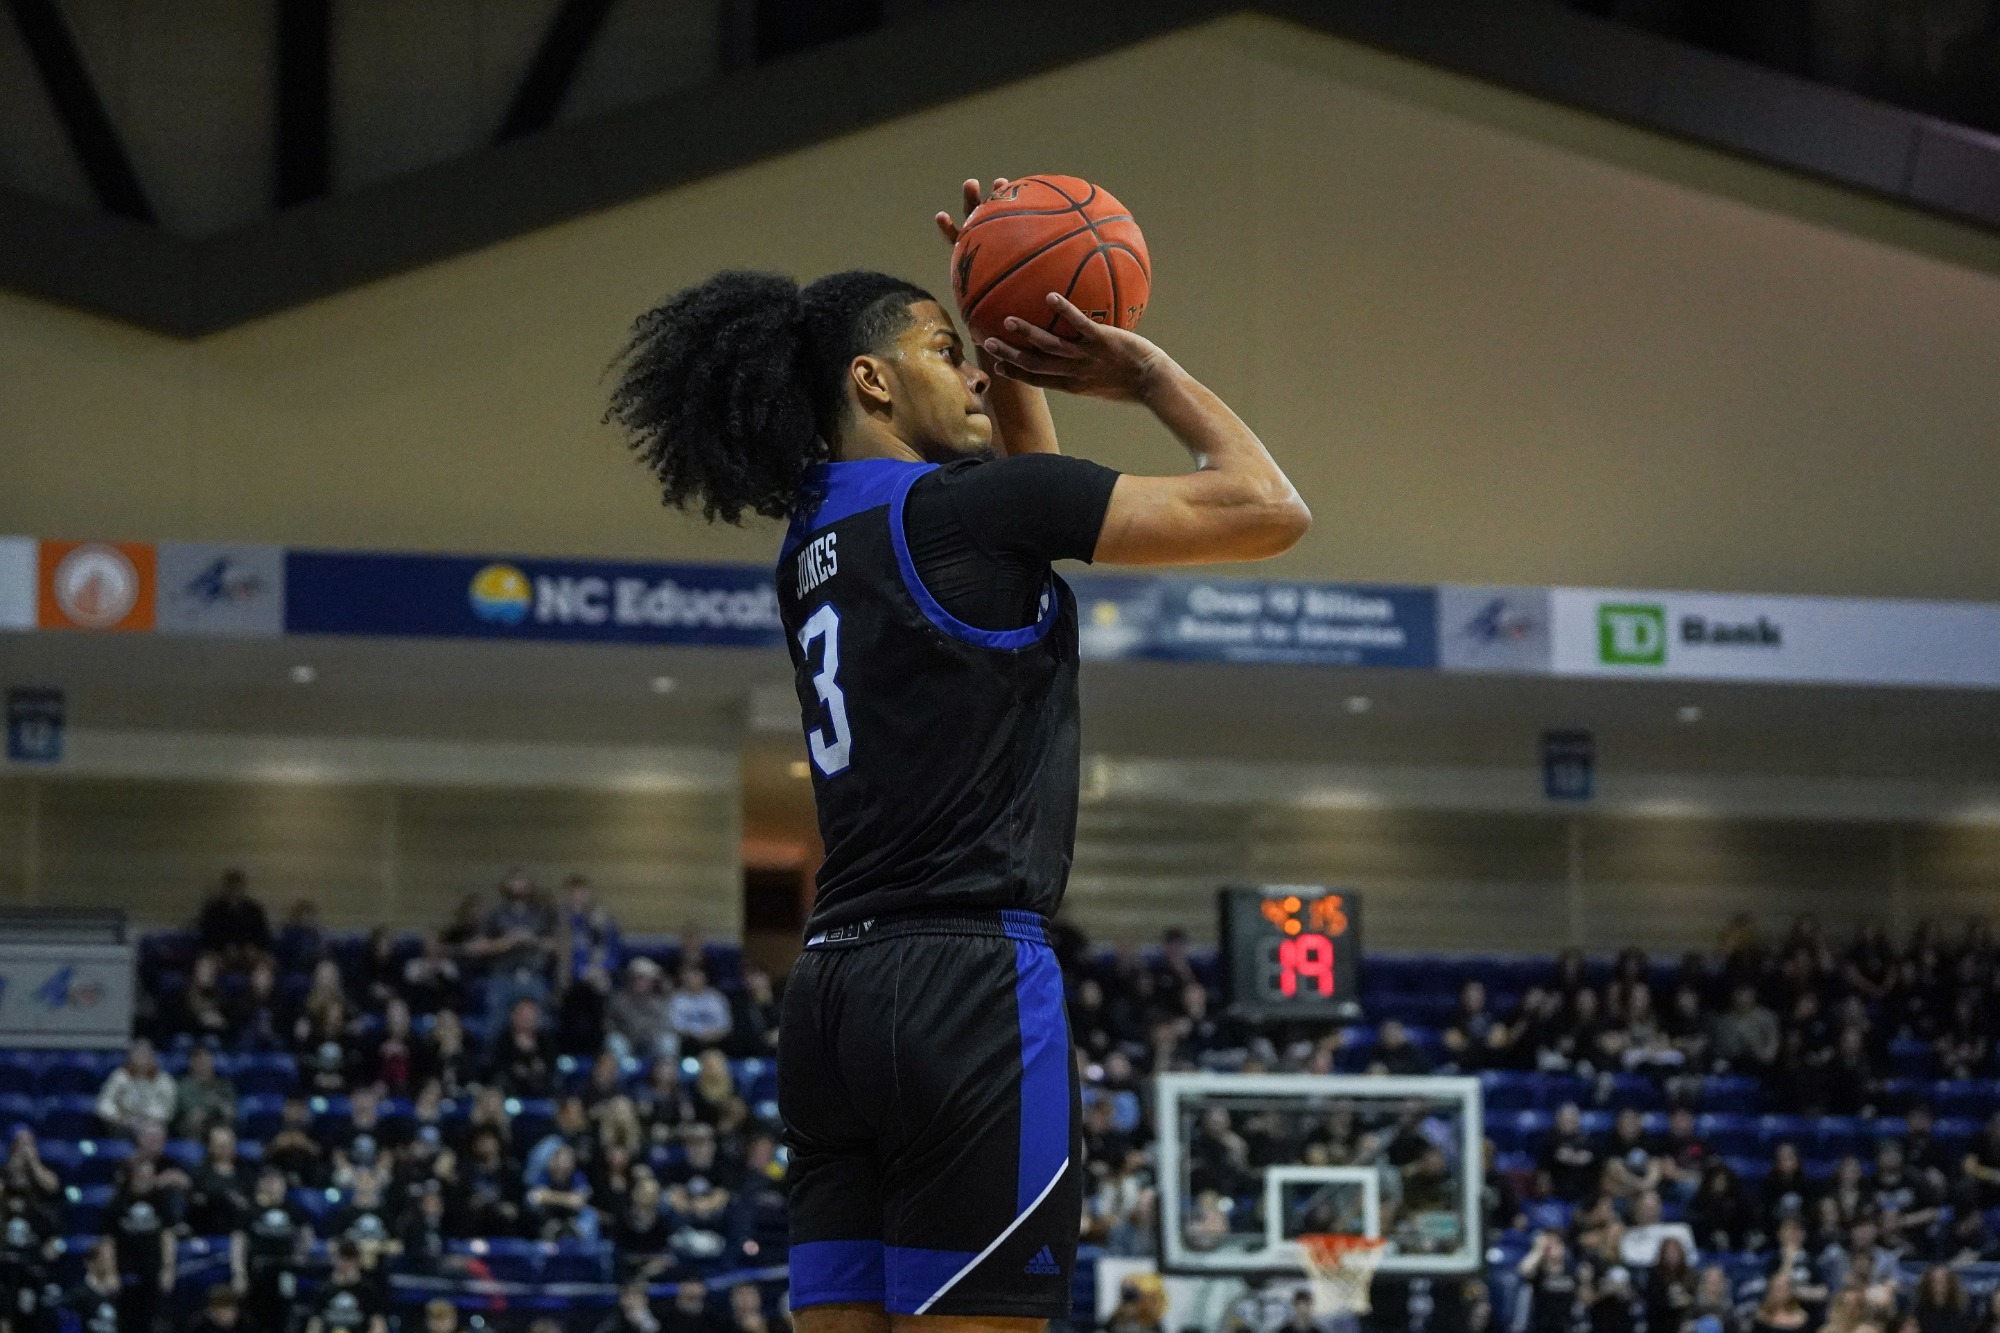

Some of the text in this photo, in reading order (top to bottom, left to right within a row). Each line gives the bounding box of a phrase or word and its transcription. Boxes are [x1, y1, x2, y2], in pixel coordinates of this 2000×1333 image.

[796, 531, 838, 600] JONES
[534, 575, 781, 630] NC Educat
[1602, 610, 1781, 655] TD Bank
[798, 602, 852, 778] 3
[1278, 933, 1334, 997] 19
